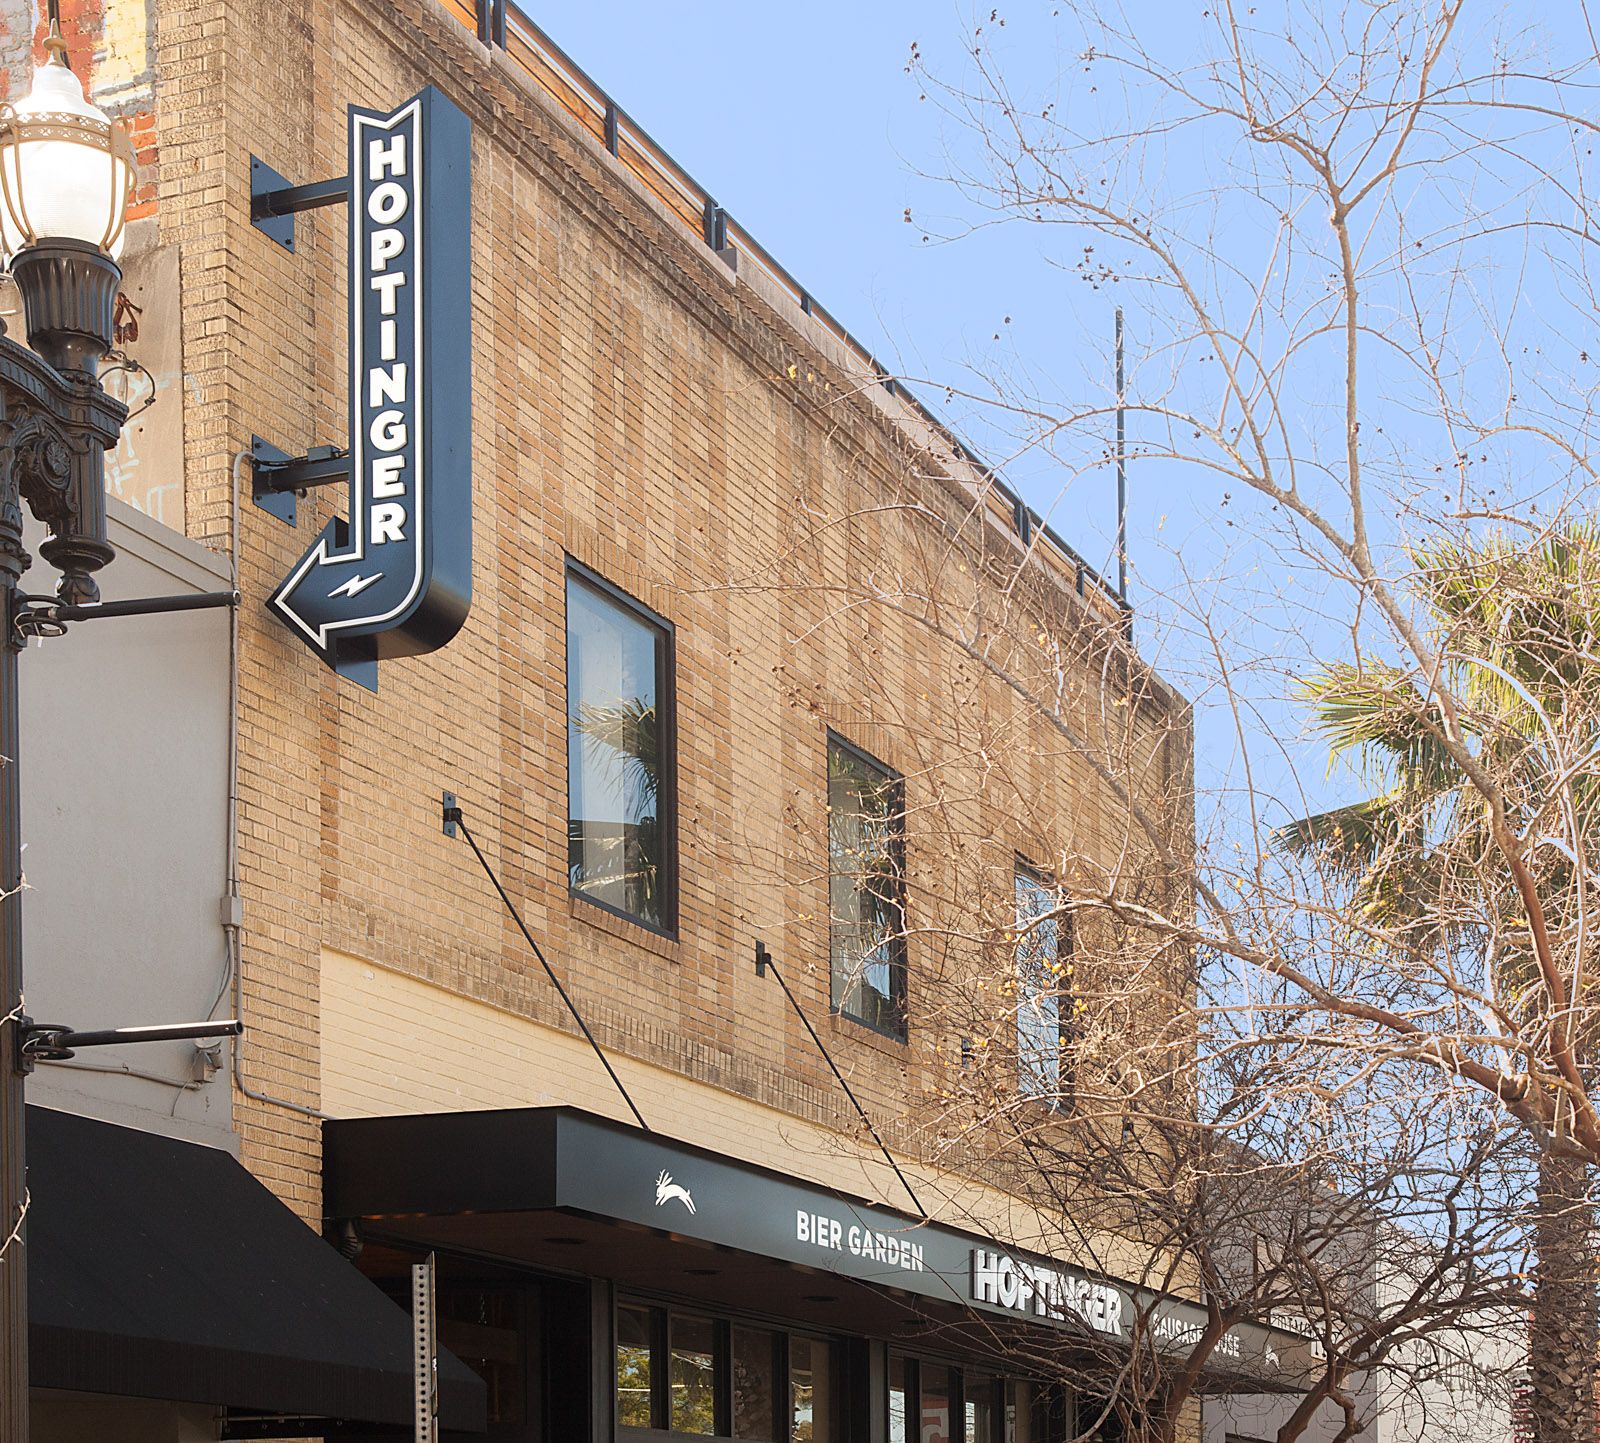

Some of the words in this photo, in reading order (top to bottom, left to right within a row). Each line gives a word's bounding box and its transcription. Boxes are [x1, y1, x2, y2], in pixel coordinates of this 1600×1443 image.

[368, 133, 408, 545] HOPTINGER
[795, 1209, 843, 1252] BIER
[848, 1225, 923, 1272] GARDEN
